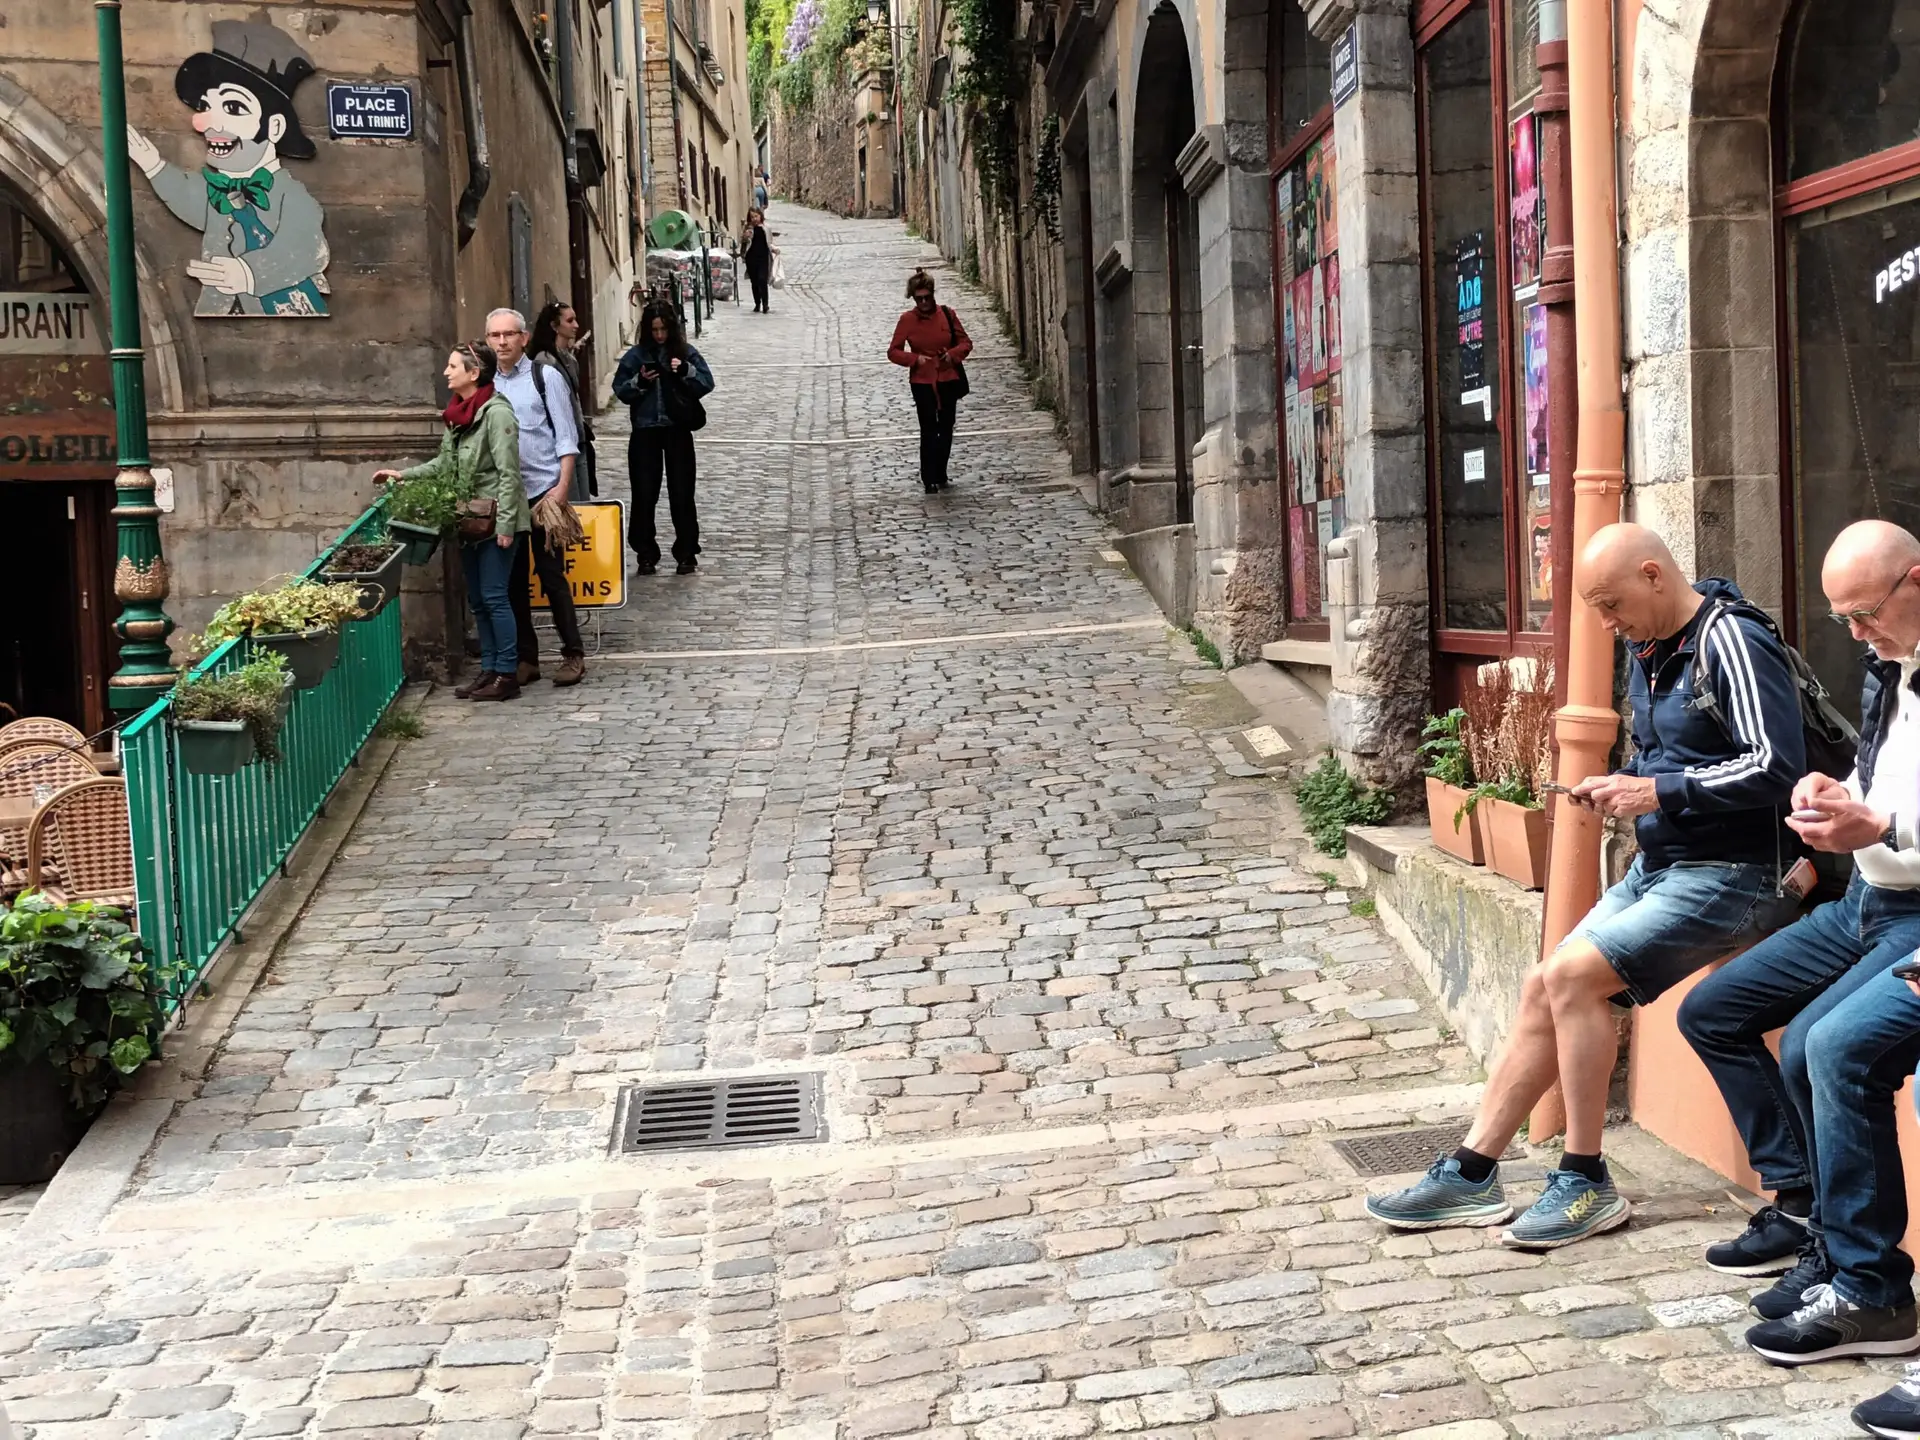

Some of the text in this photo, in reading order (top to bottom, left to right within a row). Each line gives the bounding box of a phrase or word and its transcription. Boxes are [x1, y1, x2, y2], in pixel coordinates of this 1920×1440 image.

[345, 97, 396, 111] PLACE
[336, 114, 349, 127] DE
[351, 114, 364, 127] LA
[1563, 1188, 1598, 1222] HOKA
